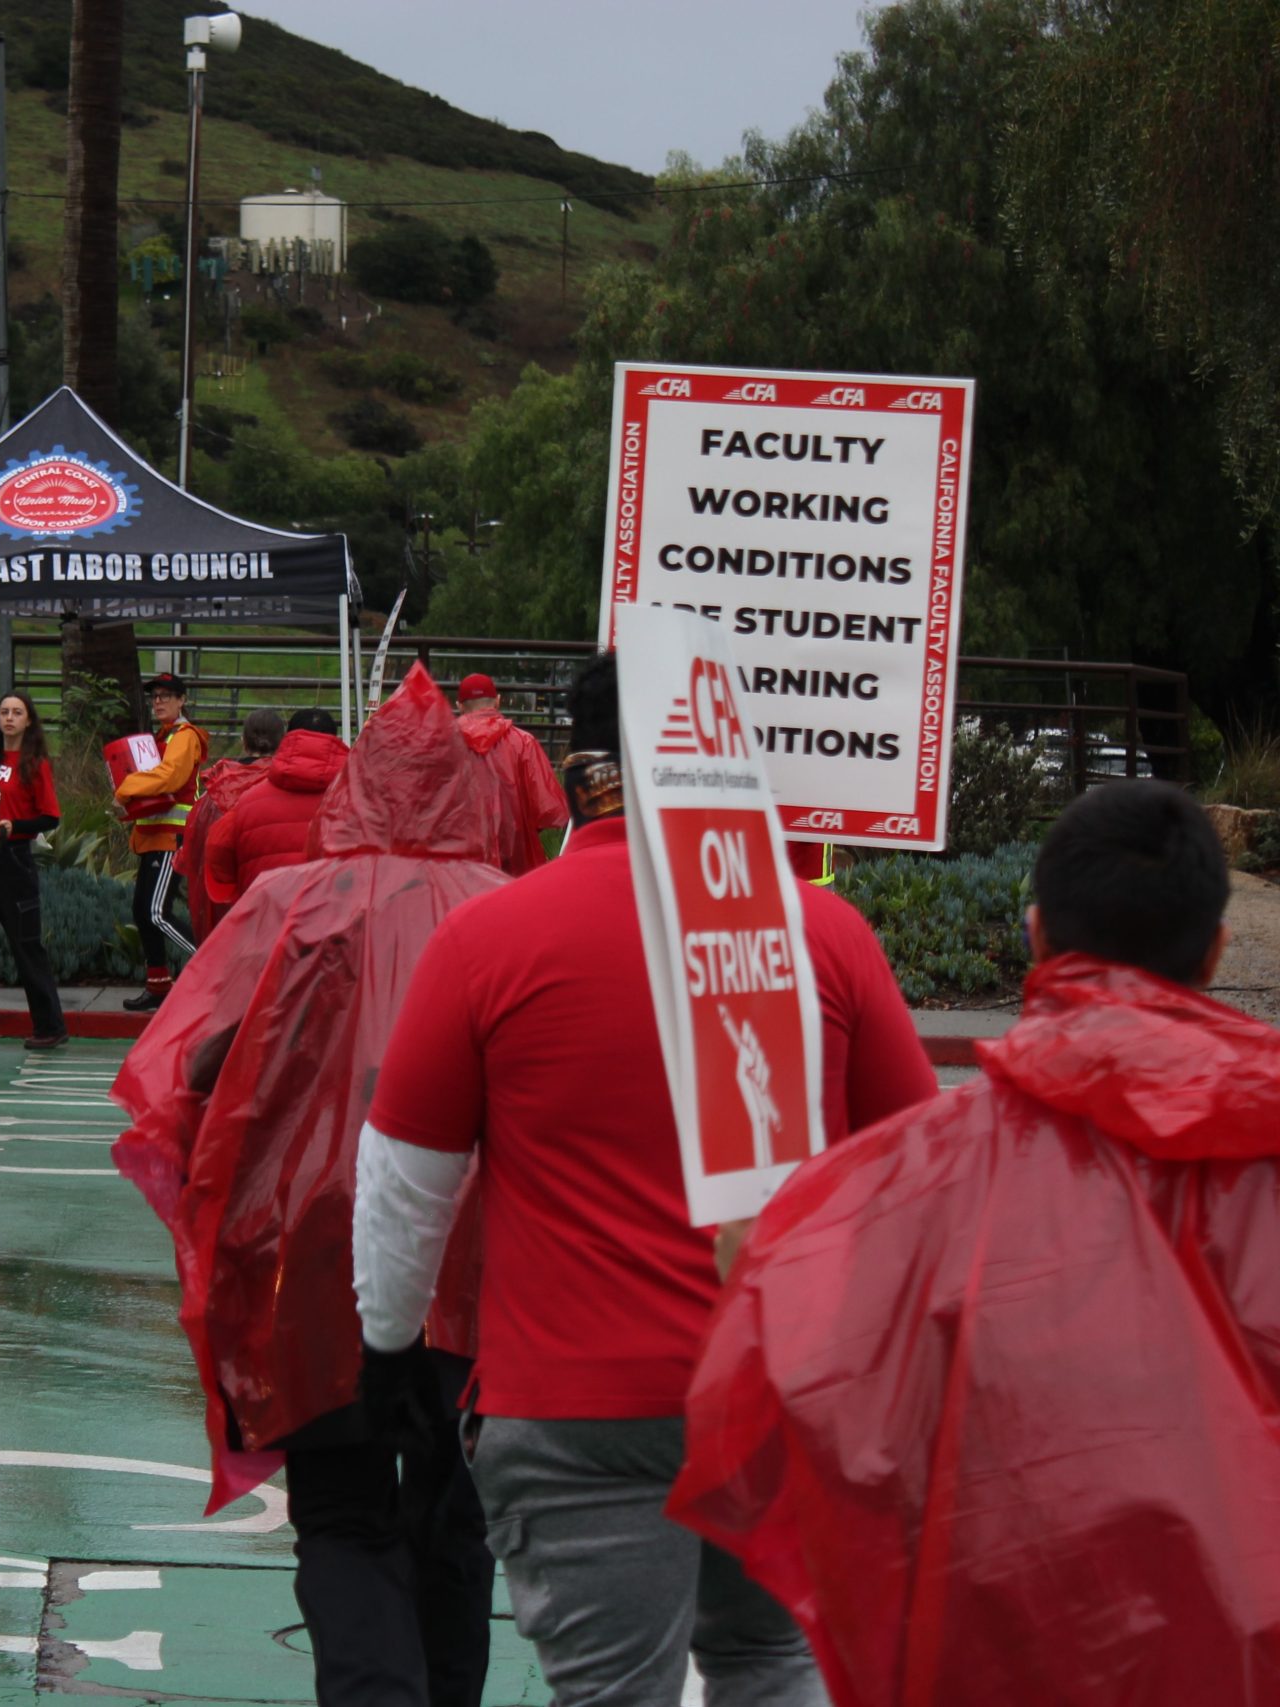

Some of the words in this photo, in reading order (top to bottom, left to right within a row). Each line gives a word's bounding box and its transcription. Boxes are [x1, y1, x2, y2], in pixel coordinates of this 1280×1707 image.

[654, 377, 692, 398] CFA
[740, 383, 776, 402] CFA
[829, 387, 865, 407] CFA
[905, 391, 943, 411] CFA
[700, 428, 885, 465] FACULTY
[14, 467, 63, 489] CENTRAL
[64, 468, 100, 489] COAST
[618, 422, 641, 556] ASSOCIATION
[688, 486, 890, 524] WORKING
[935, 438, 957, 560] CALIFORNIA
[10, 514, 46, 528] LABOR
[47, 514, 99, 528] COUNCIL
[52, 552, 143, 582] LABOR
[151, 552, 274, 582] COUNCIL
[658, 543, 912, 585] CONDITIONS
[734, 606, 922, 644] STUDENT
[928, 564, 952, 653] FACULTY
[737, 665, 880, 701] RNING
[689, 656, 750, 760] CFA
[919, 658, 945, 793] ASSOCIATION
[752, 725, 900, 761] ITIONS
[807, 811, 844, 831] CFA
[883, 815, 920, 836] CFA
[700, 828, 753, 900] ON
[683, 928, 795, 998] STRIKE!
